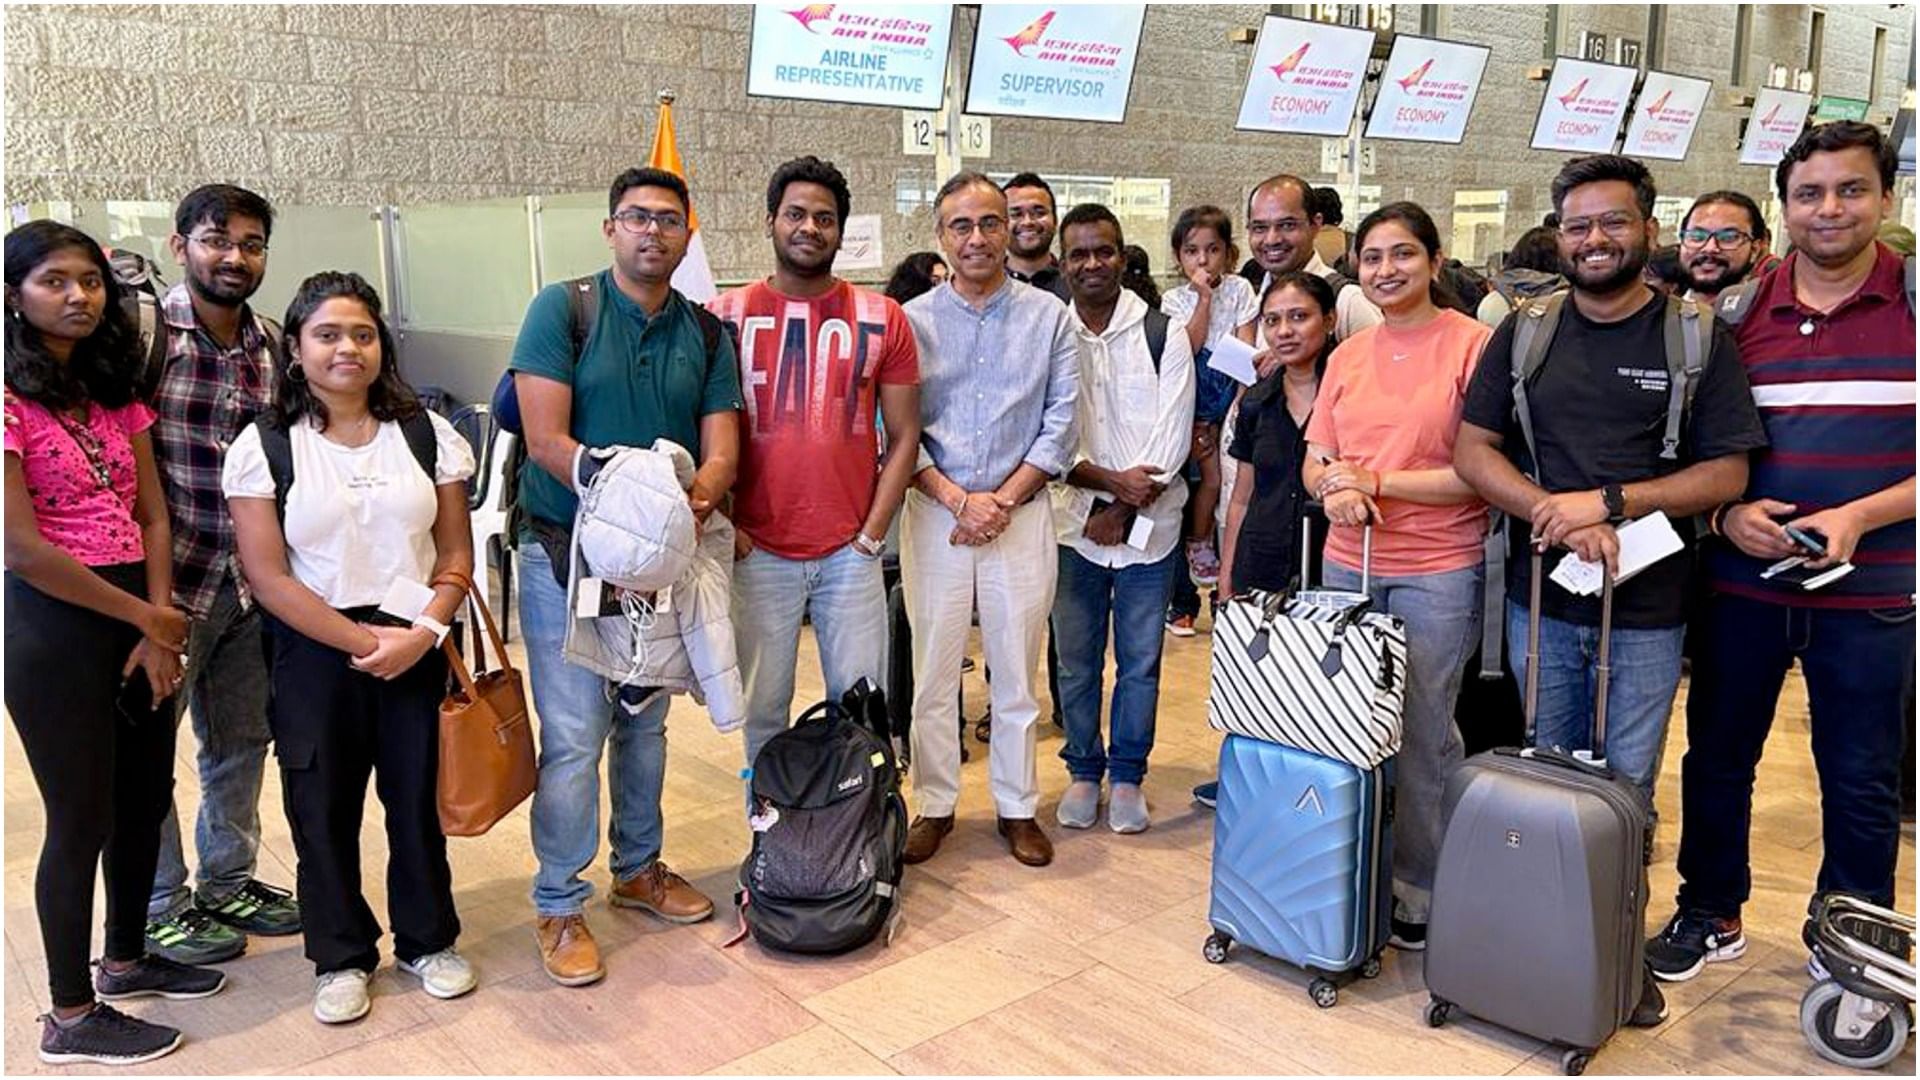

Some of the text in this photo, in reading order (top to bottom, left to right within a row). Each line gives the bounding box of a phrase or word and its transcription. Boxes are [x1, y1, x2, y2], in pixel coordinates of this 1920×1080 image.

[832, 27, 927, 46] AIR INDIA
[1589, 37, 1604, 60] 16
[1624, 44, 1638, 65] 17
[820, 49, 887, 71] AIRLINE
[1037, 51, 1117, 67] AIR INDIA
[775, 65, 924, 93] REPRESENTATIVE
[1000, 73, 1105, 98] SUPERVISOR
[1292, 76, 1349, 89] AIR INDIA
[1417, 90, 1464, 101] AIR INDIA
[1271, 96, 1332, 115] ECONOMY
[1396, 106, 1449, 125] ECONOMY
[914, 119, 930, 146] 12
[968, 122, 983, 149] 13
[1557, 121, 1601, 136] ECONOMY
[838, 774, 863, 791] safari
